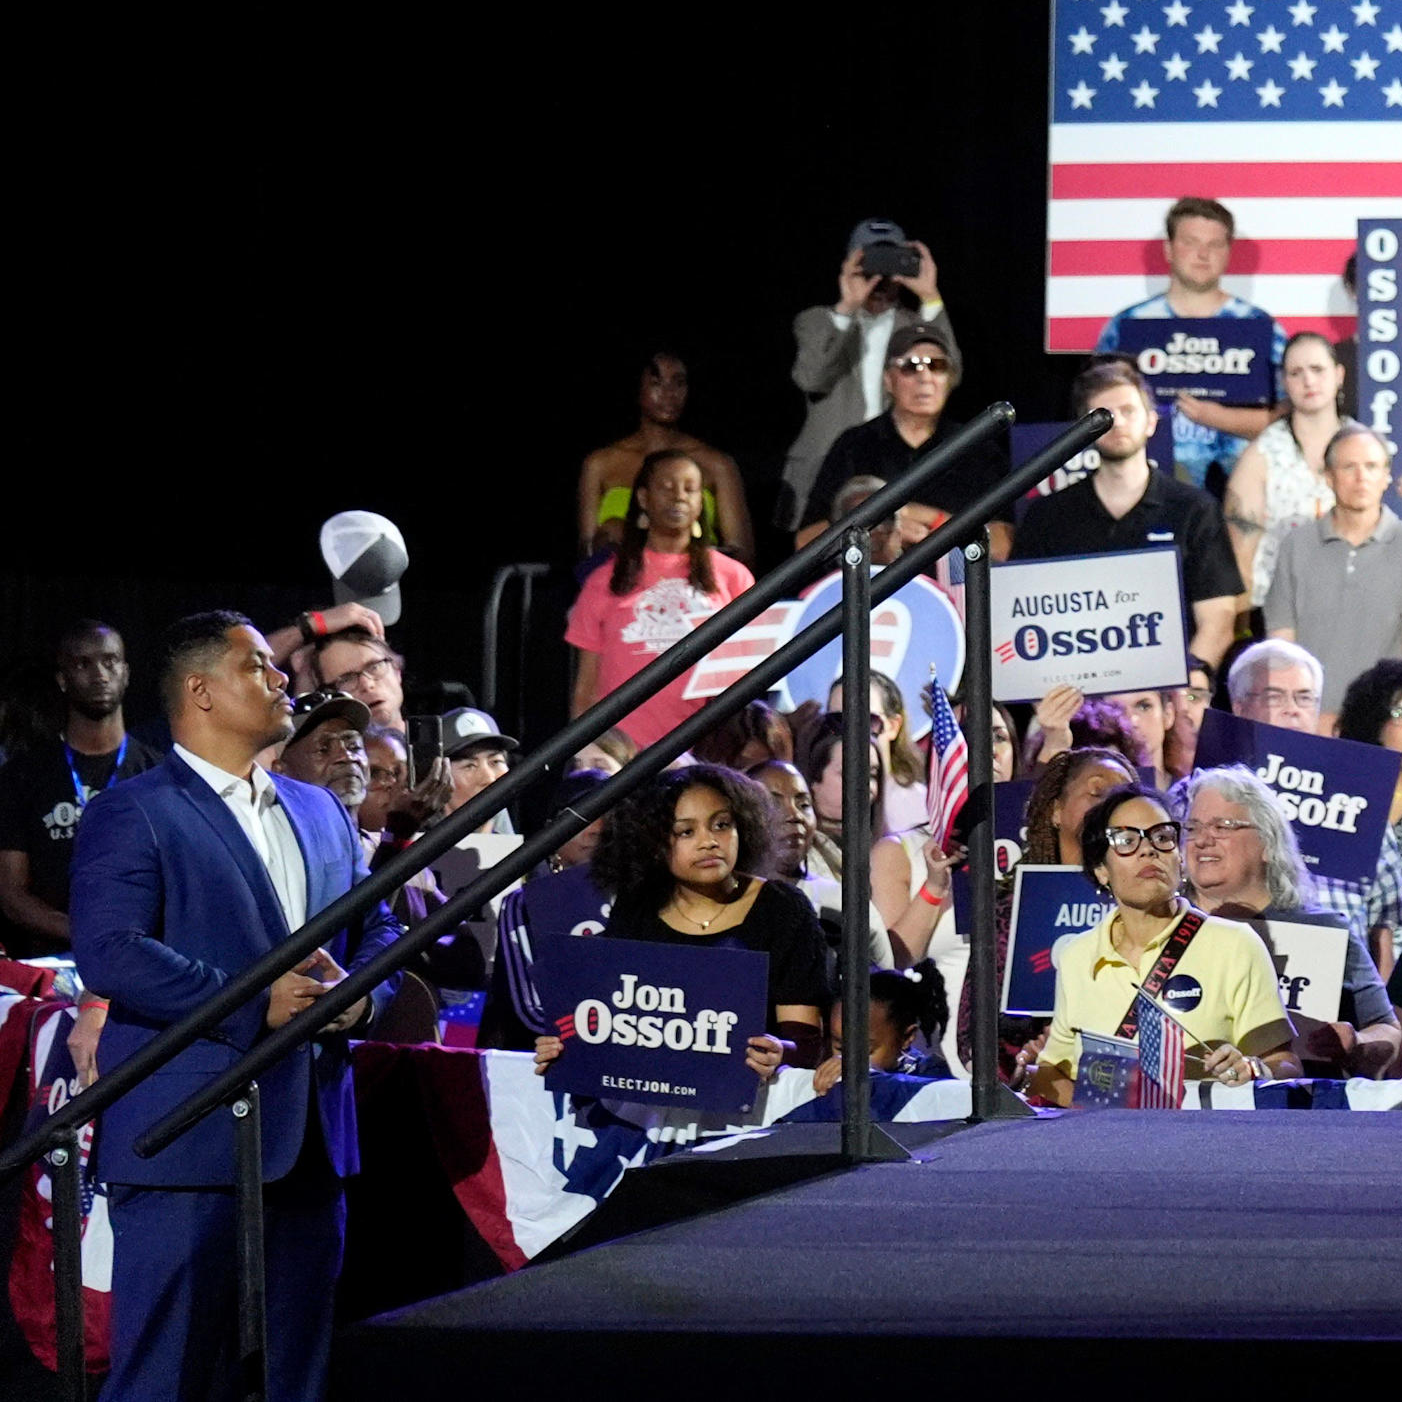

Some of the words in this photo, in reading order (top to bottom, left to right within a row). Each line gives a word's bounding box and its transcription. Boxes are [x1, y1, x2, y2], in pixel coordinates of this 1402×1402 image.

[1166, 331, 1220, 355] Jon
[1137, 347, 1256, 375] Ossoff
[1011, 589, 1109, 619] AUGUSTA
[1113, 589, 1141, 604] for
[1014, 611, 1164, 661] Ossoff
[1256, 753, 1325, 796] Jon
[1173, 913, 1202, 946] 1913
[611, 973, 687, 1014] Jon
[1166, 987, 1202, 999] Ossoff
[573, 998, 739, 1055] Ossoff
[602, 1074, 697, 1097] ELECTJON.COM
